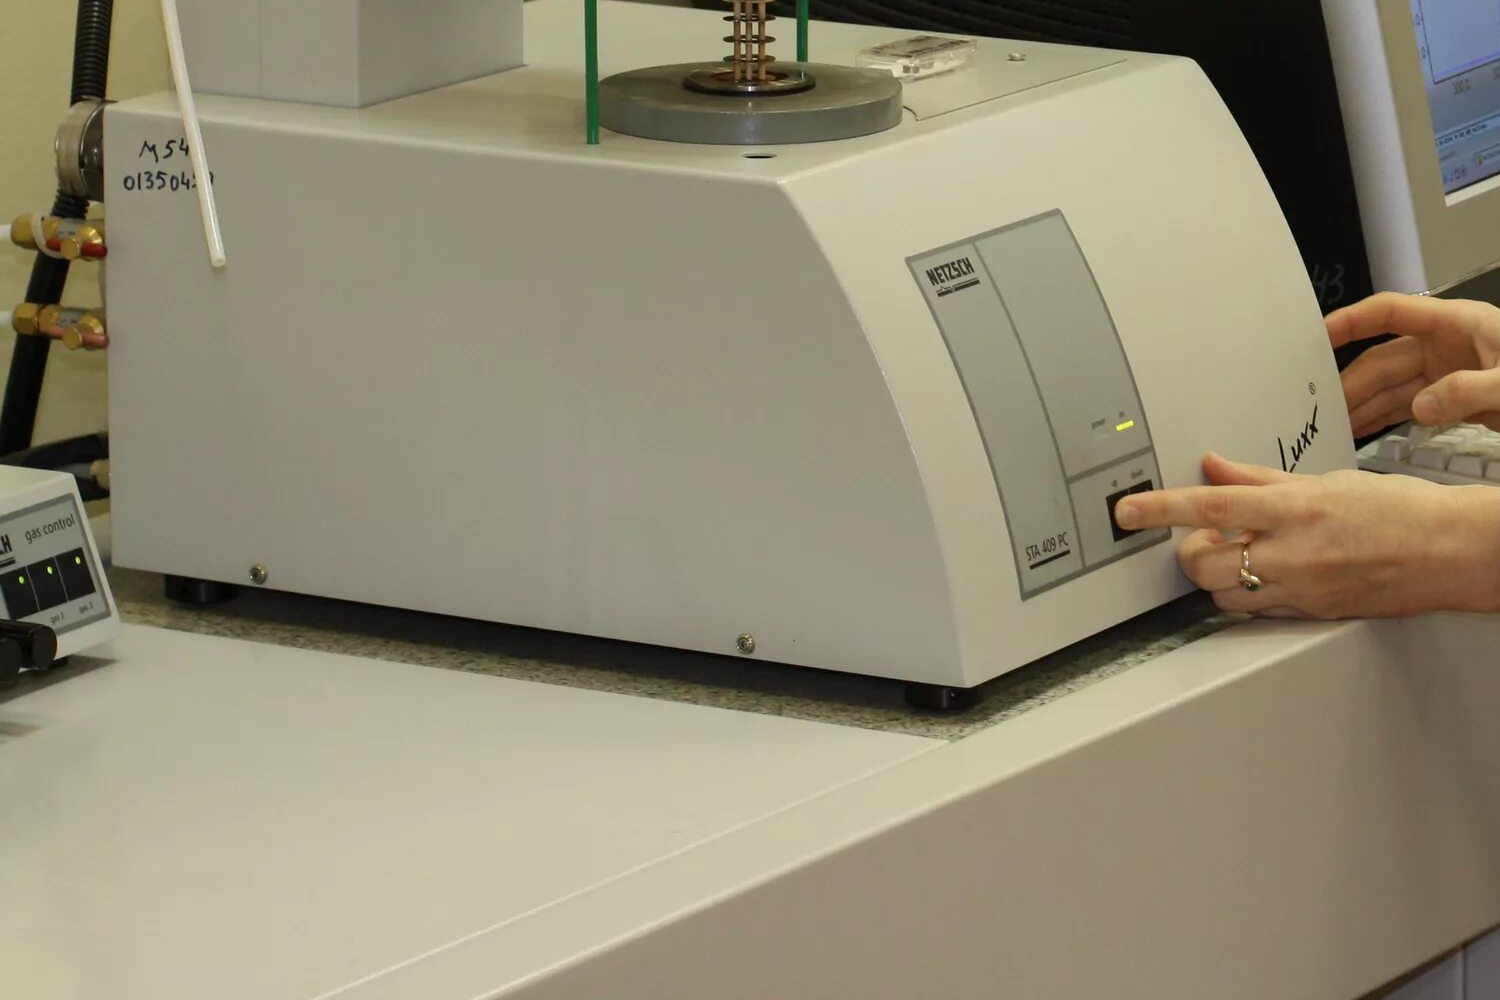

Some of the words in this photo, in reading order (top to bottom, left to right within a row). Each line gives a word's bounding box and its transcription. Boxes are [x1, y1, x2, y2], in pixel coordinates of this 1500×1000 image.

[926, 257, 975, 286] NETZSCH
[25, 527, 42, 545] gas
[43, 514, 76, 536] control
[1025, 544, 1041, 561] STA
[1058, 531, 1069, 547] PC
